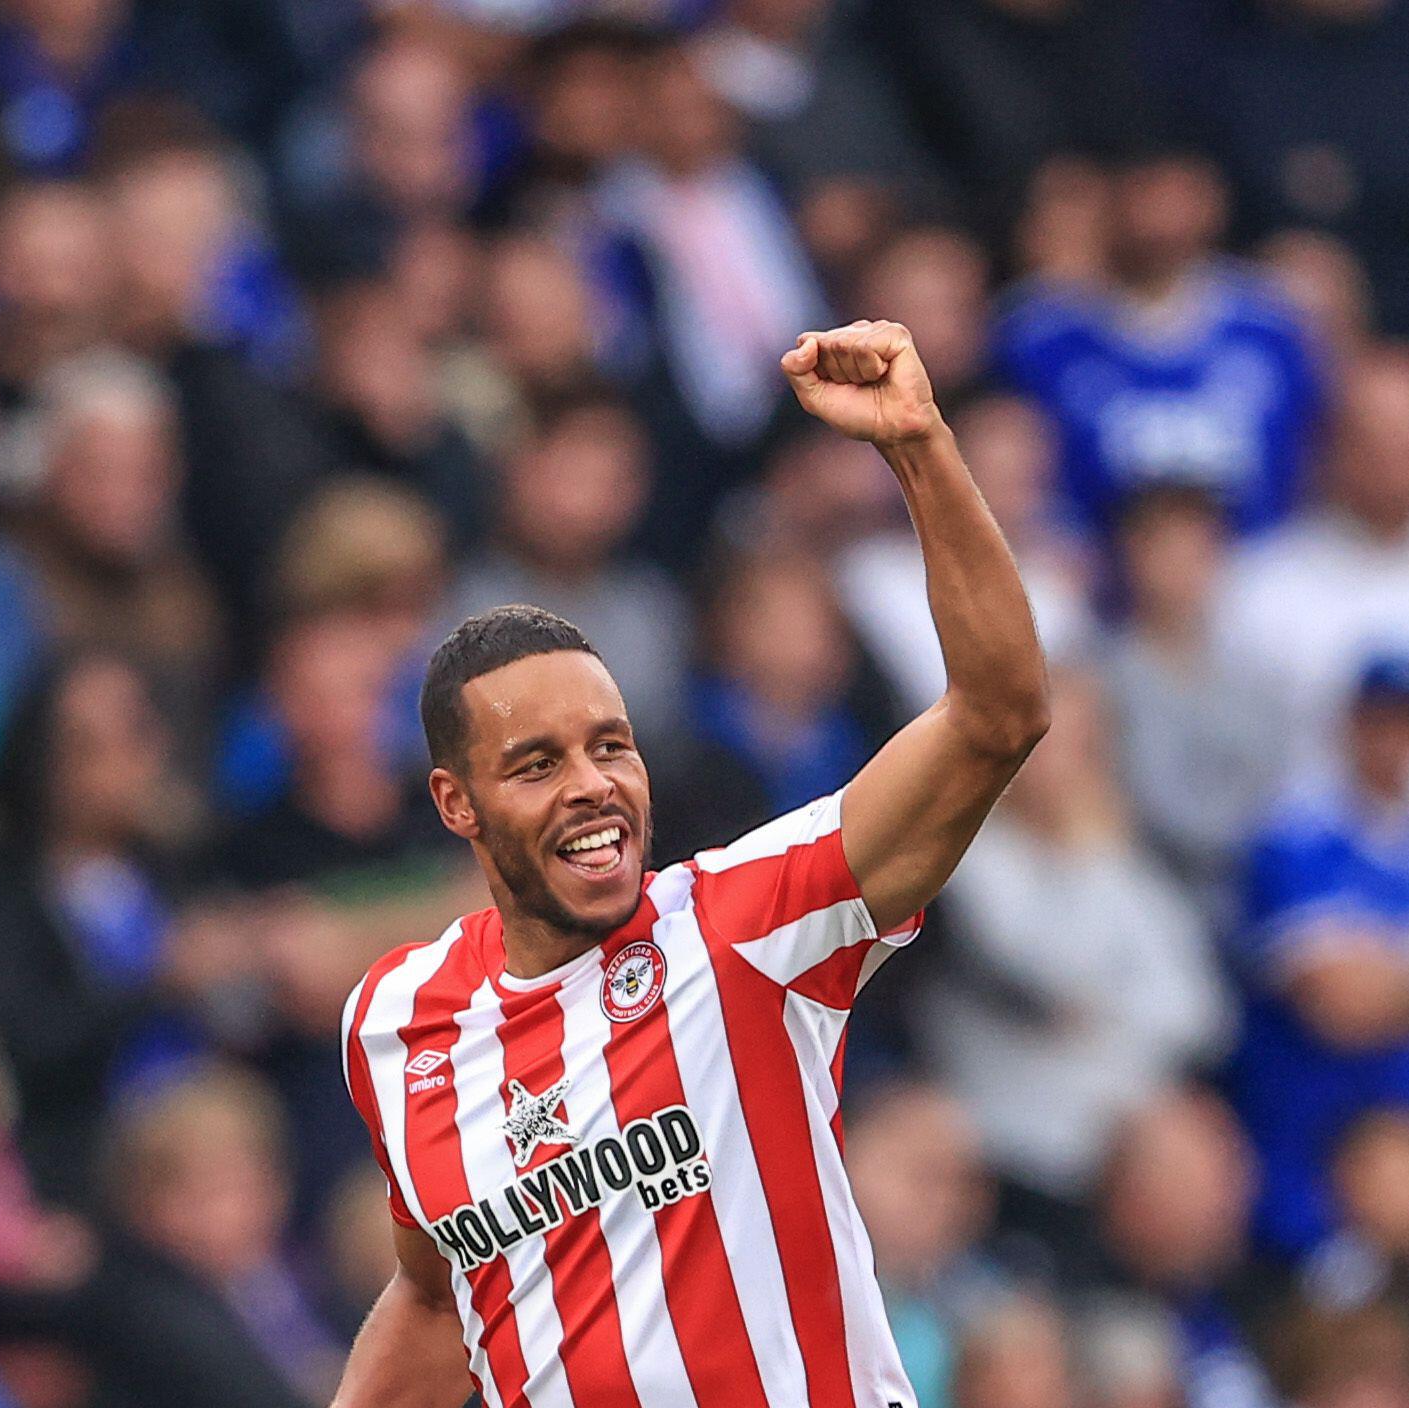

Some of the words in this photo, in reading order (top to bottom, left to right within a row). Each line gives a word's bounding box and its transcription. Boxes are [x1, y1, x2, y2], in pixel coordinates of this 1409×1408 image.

[408, 1075, 446, 1095] umbro
[433, 1109, 701, 1270] HOLLYWOOD
[636, 1163, 711, 1210] bets
